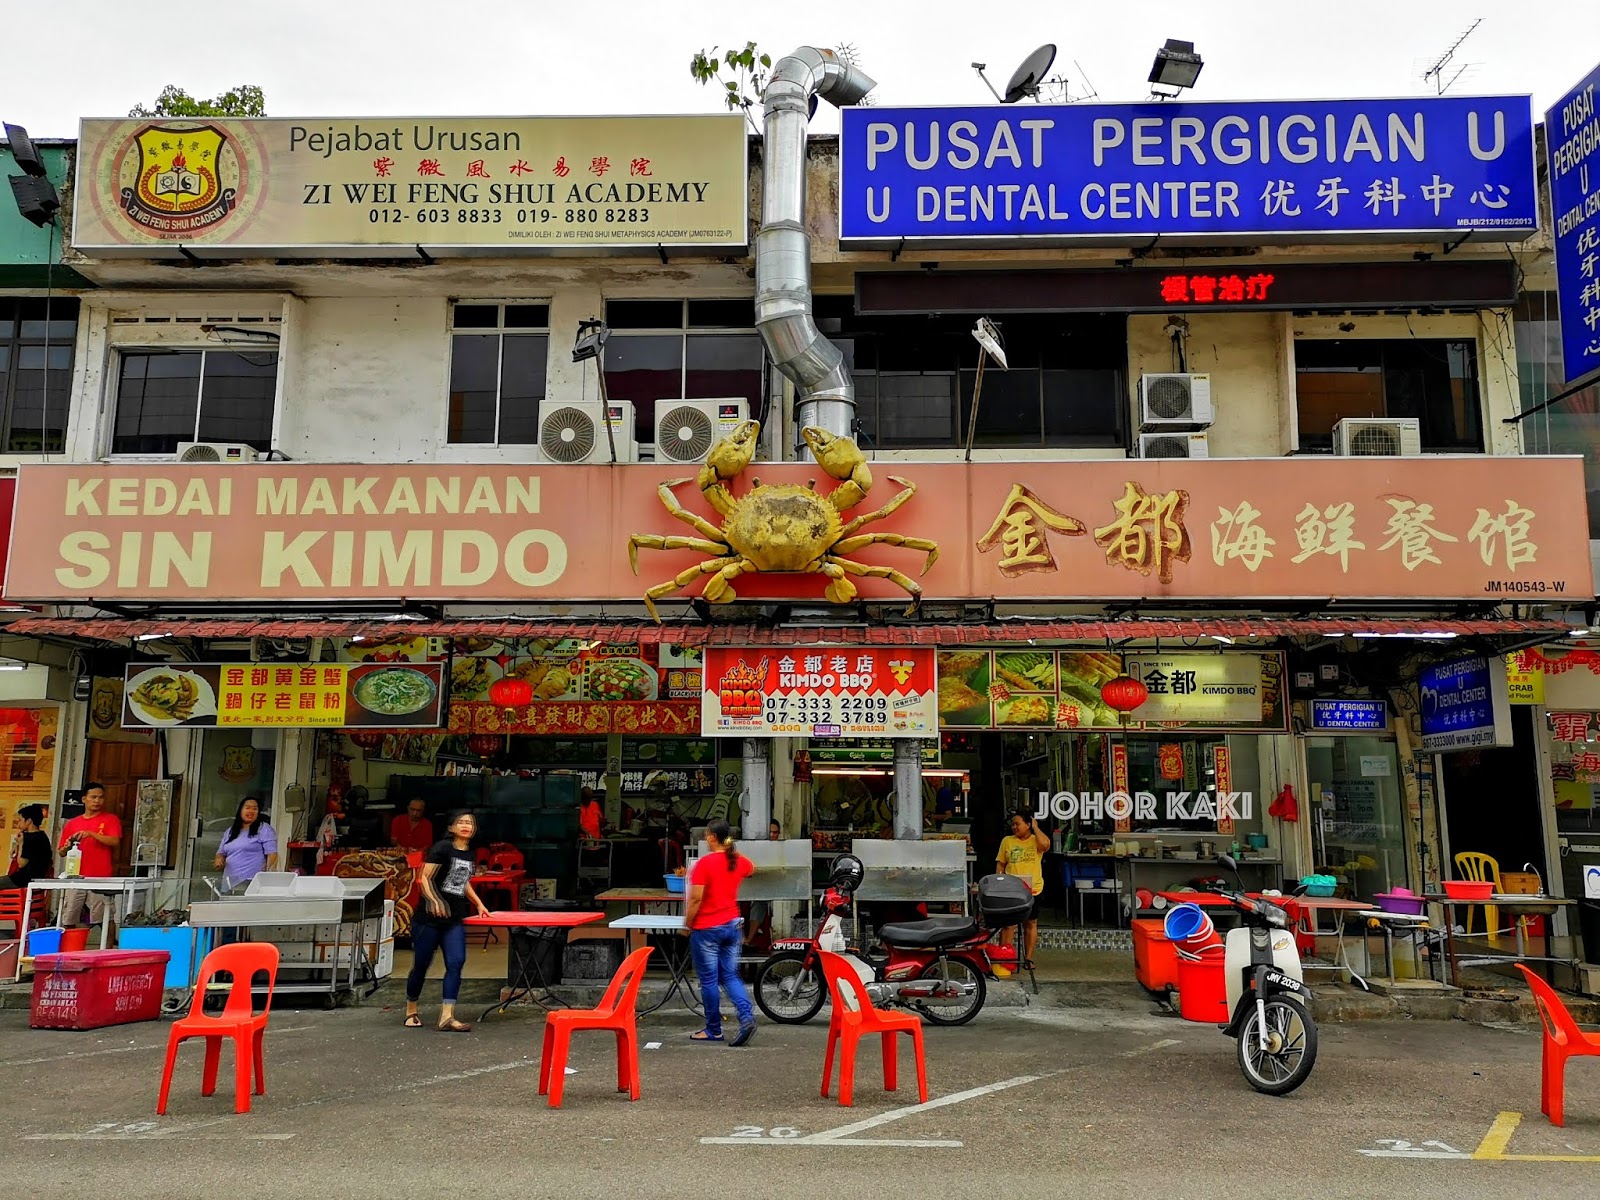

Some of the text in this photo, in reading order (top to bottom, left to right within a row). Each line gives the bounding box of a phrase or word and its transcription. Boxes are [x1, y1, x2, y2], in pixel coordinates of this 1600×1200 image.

[1562, 83, 1594, 137] PUSAT
[290, 125, 521, 159] Pejabat Urusan
[867, 111, 1505, 171] PUSAT PERGIGIAN U
[1580, 163, 1589, 195] U
[303, 182, 710, 205] ZI WEI FENG SHUI ACADEMY
[866, 180, 1240, 223] U DENTAL CENTER
[1259, 174, 1510, 217] 优牙科中心
[128, 205, 226, 230] ZI WEI FENG SHUI ACADEMY
[416, 209, 450, 224] 603
[457, 209, 503, 223] 8833
[564, 209, 598, 223] 880
[604, 208, 650, 223] 8283
[1557, 189, 1600, 239] DENTAL CEN
[508, 231, 535, 239] DIMILIKI
[656, 230, 689, 238] ACADEMY
[65, 476, 542, 517] KEDAI MAKANAN
[54, 528, 569, 590] SIN KIMDO
[1484, 580, 1566, 594] JM140543-W
[778, 655, 874, 674] 金都老店
[1435, 657, 1486, 681] PUSAT PERGIGIAN
[721, 679, 761, 690] KIMDO
[780, 673, 874, 690] KIMDO BBQ
[1143, 670, 1197, 695] 金都
[1202, 687, 1256, 695] KIMDO BBQ
[1457, 676, 1464, 690] U
[1509, 684, 1533, 692] CRAB
[721, 690, 762, 707] BBQ
[766, 697, 832, 711] 07-333
[841, 697, 888, 711] 2209
[1315, 703, 1337, 711] PUSAT
[1339, 703, 1375, 711] PERGIGIAN
[1440, 687, 1487, 708] DENTAL CENTER
[501, 706, 584, 727] 喜發財
[766, 712, 832, 725] 07-332
[841, 712, 888, 725] 3789
[1551, 712, 1600, 743] 霸
[1456, 731, 1494, 746] www.gigi.my
[1266, 972, 1300, 991] JMV 2038
[731, 1125, 802, 1139] 20
